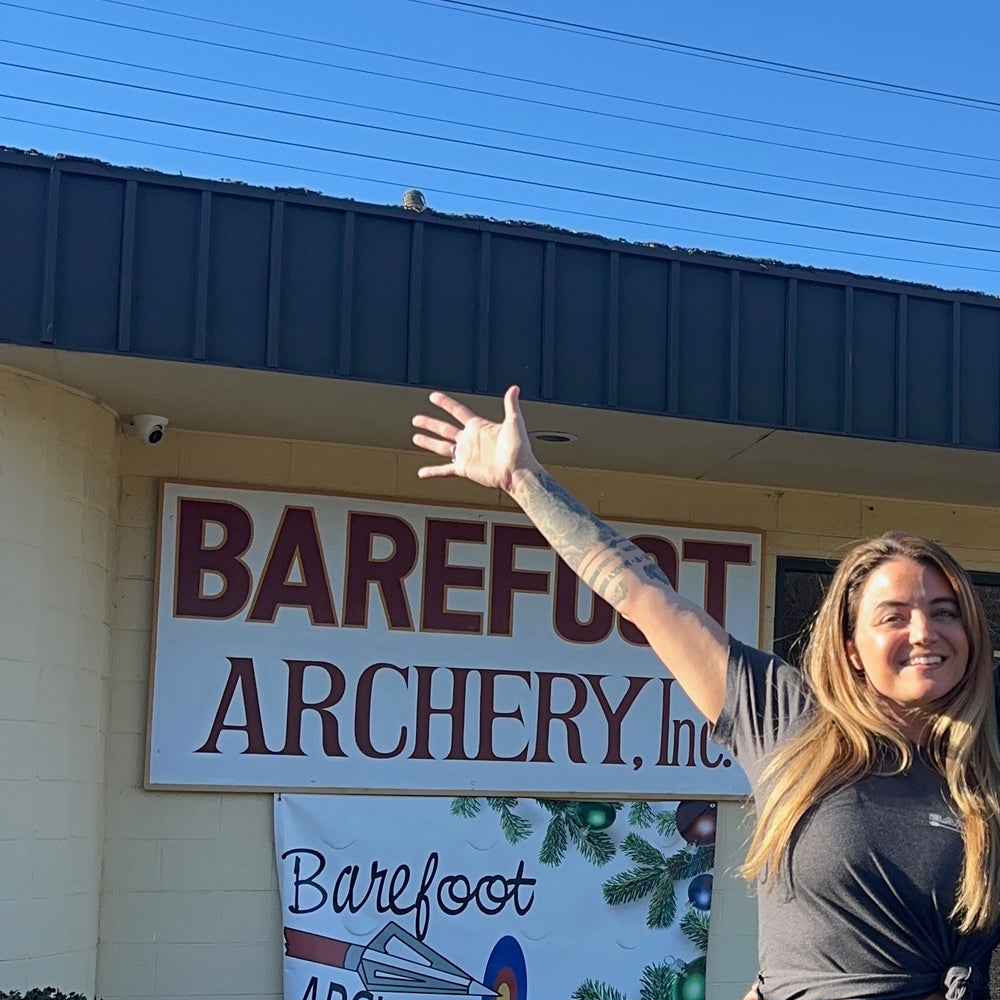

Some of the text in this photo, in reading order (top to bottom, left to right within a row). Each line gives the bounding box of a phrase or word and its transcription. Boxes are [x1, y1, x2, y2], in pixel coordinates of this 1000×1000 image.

[193, 656, 732, 771] ARCHERY, Inc.
[281, 848, 537, 941] Barefoot
